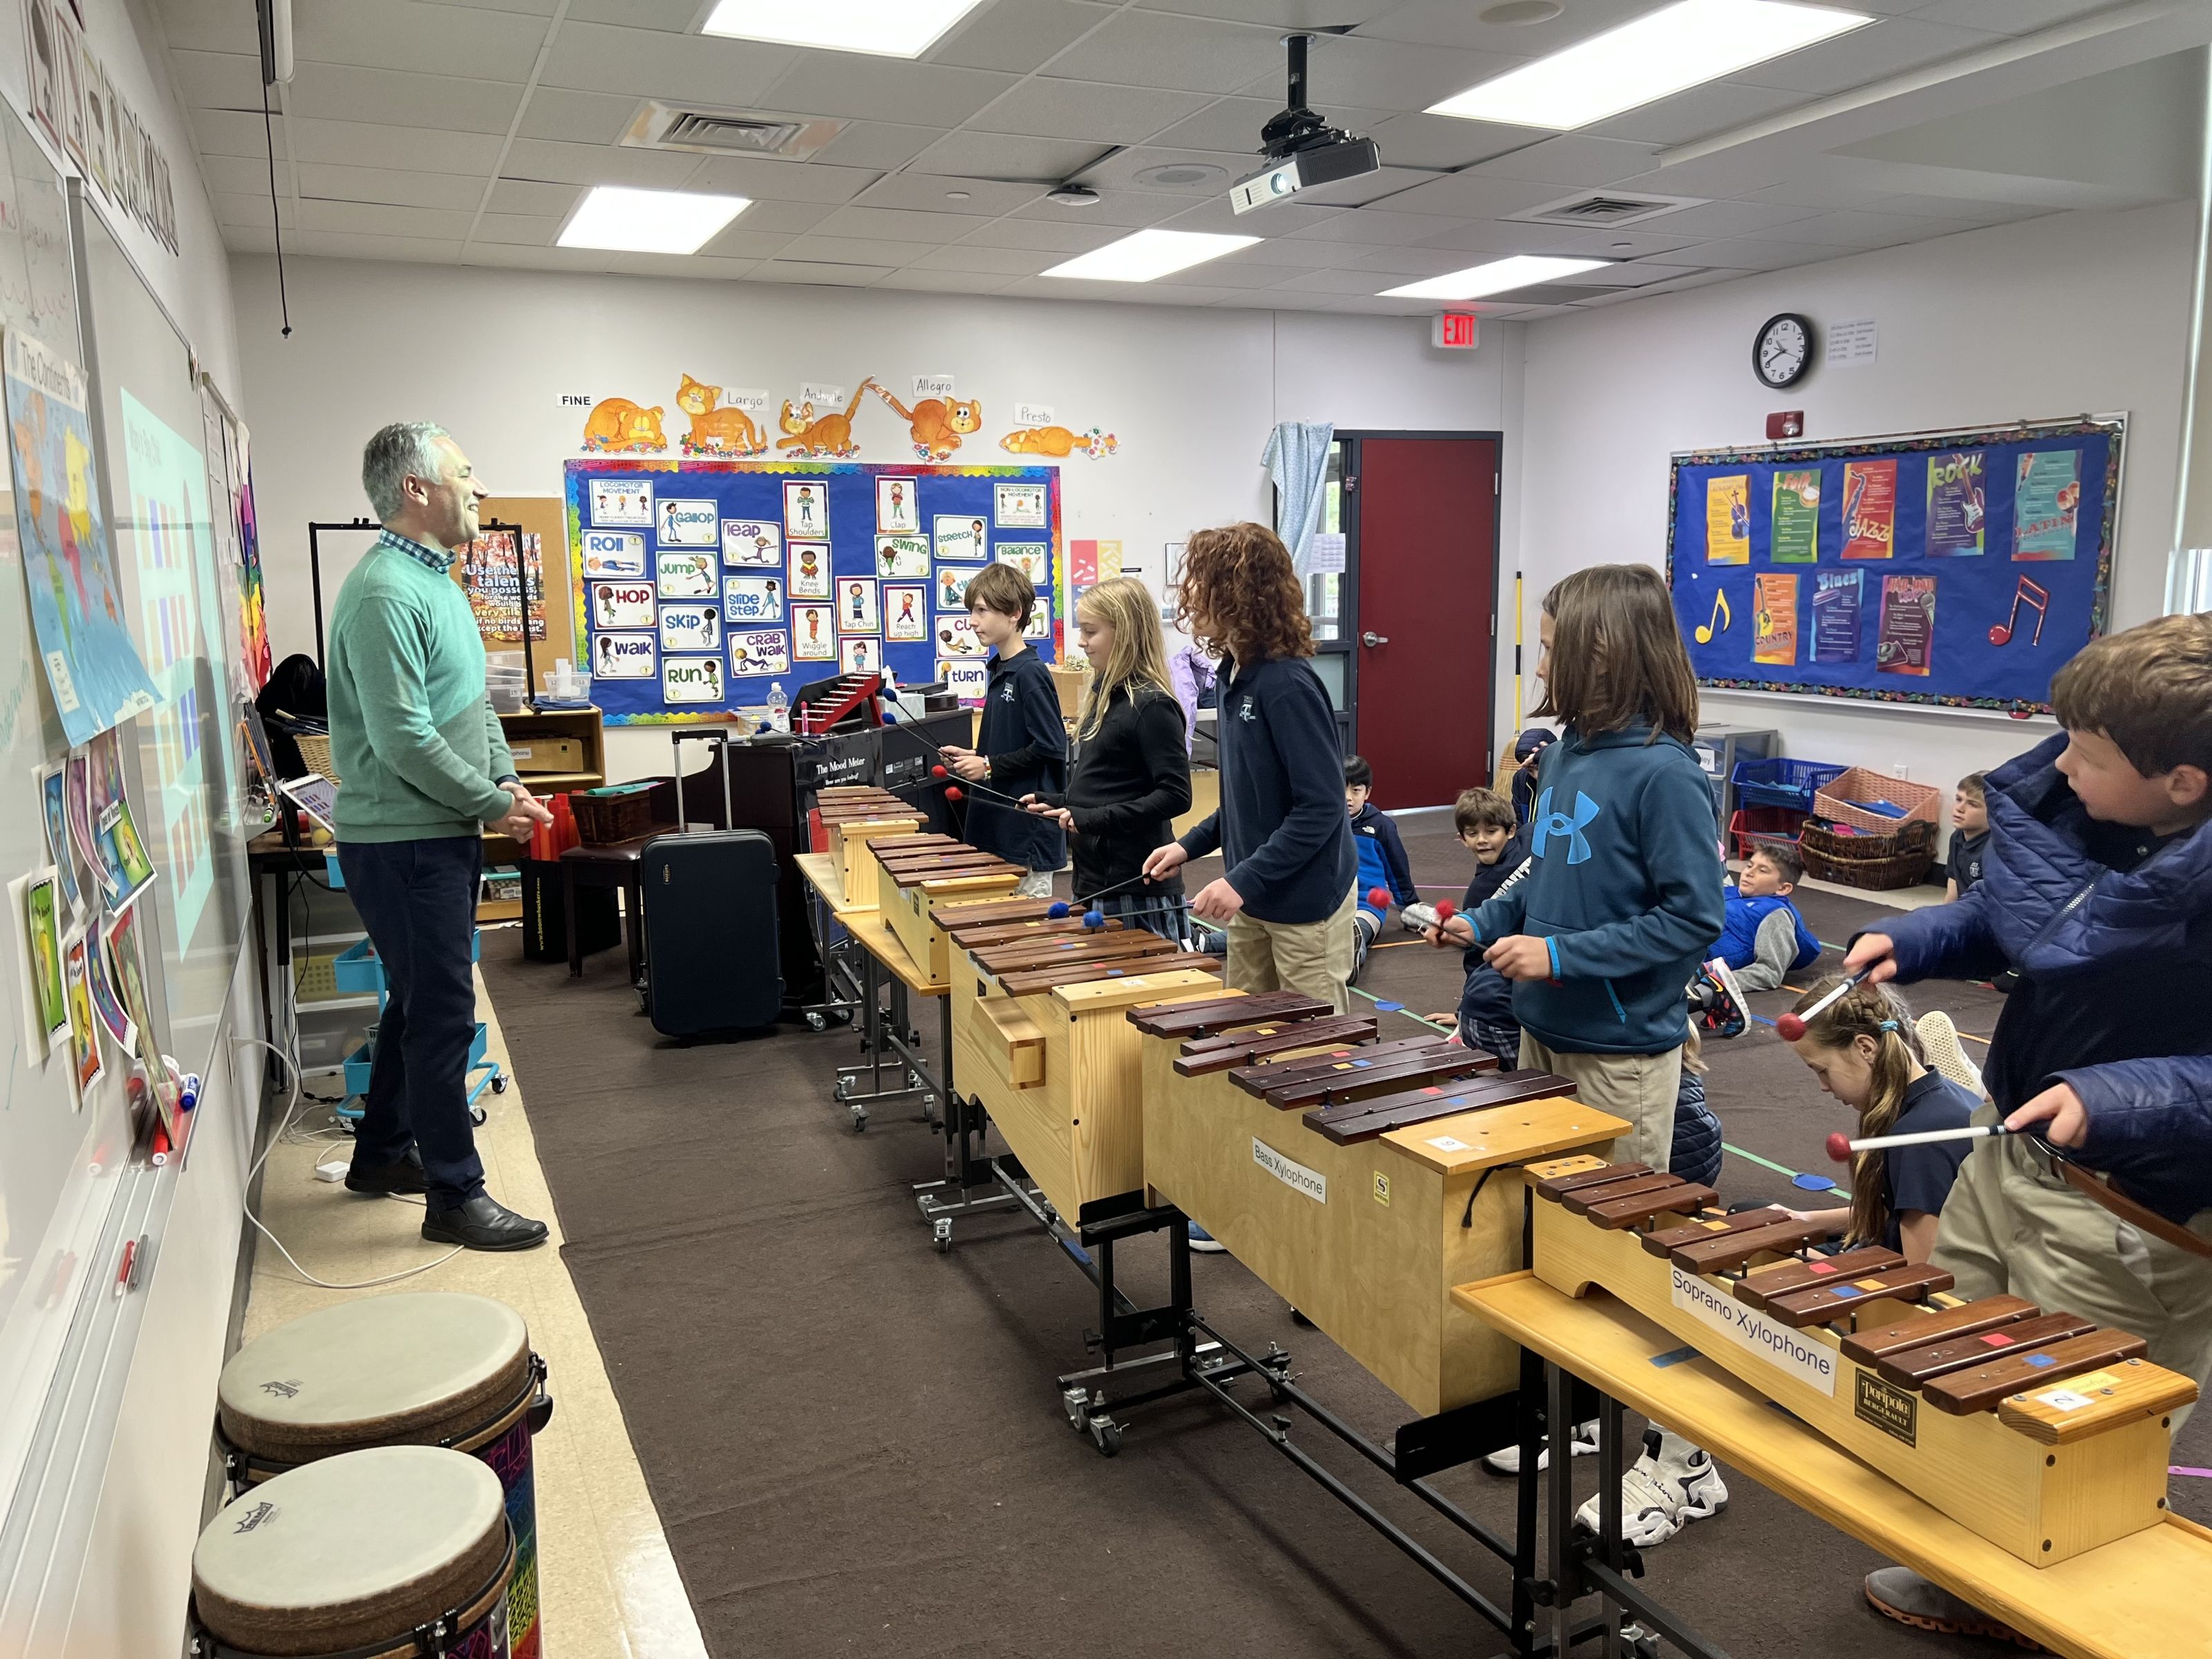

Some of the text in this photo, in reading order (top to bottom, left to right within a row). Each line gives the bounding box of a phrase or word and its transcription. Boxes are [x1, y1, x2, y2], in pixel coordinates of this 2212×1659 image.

[1443, 315, 1474, 346] EXIT
[1781, 323, 1789, 331] 12
[1765, 337, 1772, 346] 10
[1797, 332, 1803, 341] 2
[21, 341, 37, 382] The
[1770, 369, 1777, 377] 7
[916, 379, 952, 394] Allegro
[561, 395, 591, 406] FINE
[727, 392, 763, 409] Largo
[1020, 406, 1051, 422] Presto
[789, 527, 825, 536] Shoulders
[800, 521, 813, 530] Tap
[890, 521, 906, 530] Clap
[2015, 513, 2074, 538] LATIN
[466, 564, 517, 575] Use the
[477, 574, 535, 587] talens
[1817, 571, 1858, 590] Blues
[502, 608, 532, 617] silet
[844, 621, 856, 629] Tap
[904, 630, 919, 638] high
[1755, 630, 1793, 645] COUNTRY
[802, 641, 827, 650] Wiggle
[803, 648, 827, 657] around
[816, 757, 865, 775] The Mood Meter
[536, 877, 545, 951] www.boomwhackers.com
[1255, 1144, 1323, 1195] Bass Xylophone
[1673, 1270, 1830, 1375] Soprano Xylophone
[1863, 1398, 1907, 1426] BERGERAULT
[245, 1506, 270, 1529] REMO
